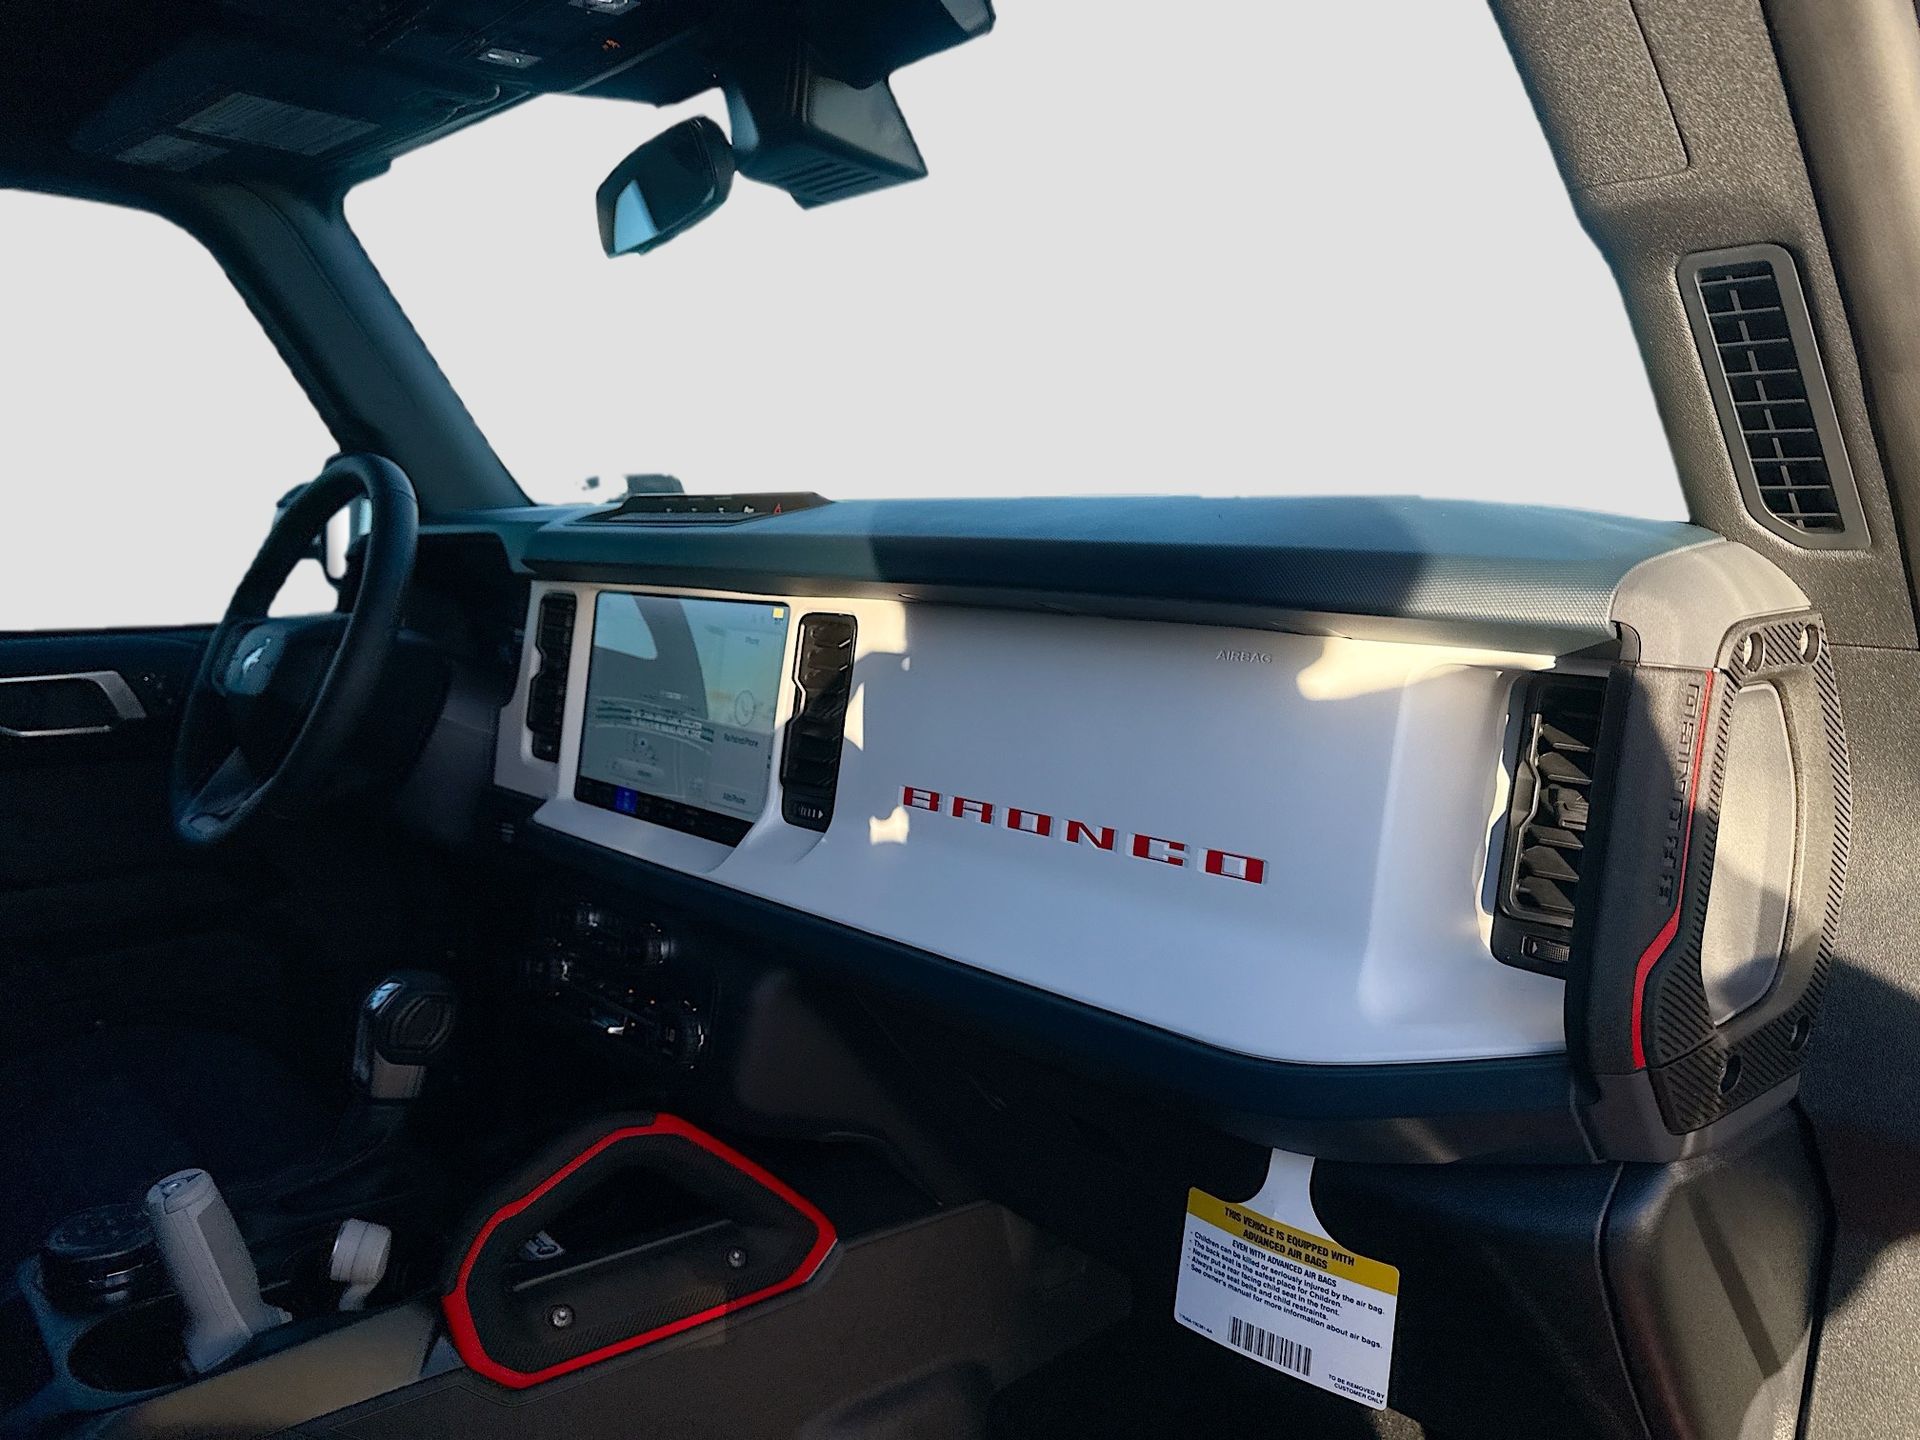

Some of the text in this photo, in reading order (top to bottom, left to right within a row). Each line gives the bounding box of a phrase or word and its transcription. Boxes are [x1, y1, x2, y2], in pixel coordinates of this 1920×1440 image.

[1216, 649, 1273, 664] AIRBAG
[901, 785, 1269, 884] BRONCO
[1225, 1207, 1355, 1266] THIS VEHICLE IS EQUIPPED WITH
[1232, 1240, 1337, 1288] EVEN WITH ADVANCED AIR BAGS
[1243, 1229, 1328, 1269] ADVANCED AIR BAGS
[1191, 1264, 1383, 1349] See owner's manual for more information about air bags.
[1192, 1256, 1329, 1321] Always use seat belts and child restraints.
[1193, 1248, 1210, 1261] Never
[1211, 1258, 1221, 1267] put
[1227, 1267, 1240, 1276] rear
[1242, 1271, 1262, 1287] facing
[1263, 1282, 1281, 1293] child
[1282, 1290, 1297, 1300] seat
[1298, 1295, 1306, 1304] in
[1307, 1299, 1319, 1309] the
[1320, 1303, 1340, 1316] front.
[1194, 1240, 1343, 1309] The back seat is the safest place for Children.
[1195, 1232, 1220, 1249] Children
[1221, 1246, 1232, 1255] can
[1233, 1251, 1241, 1260] be
[1243, 1255, 1260, 1268] killed
[1270, 1268, 1303, 1286] seriously
[1304, 1280, 1330, 1295] injured
[1331, 1290, 1341, 1300] by
[1343, 1294, 1355, 1304] the
[1368, 1303, 1385, 1315] bag.
